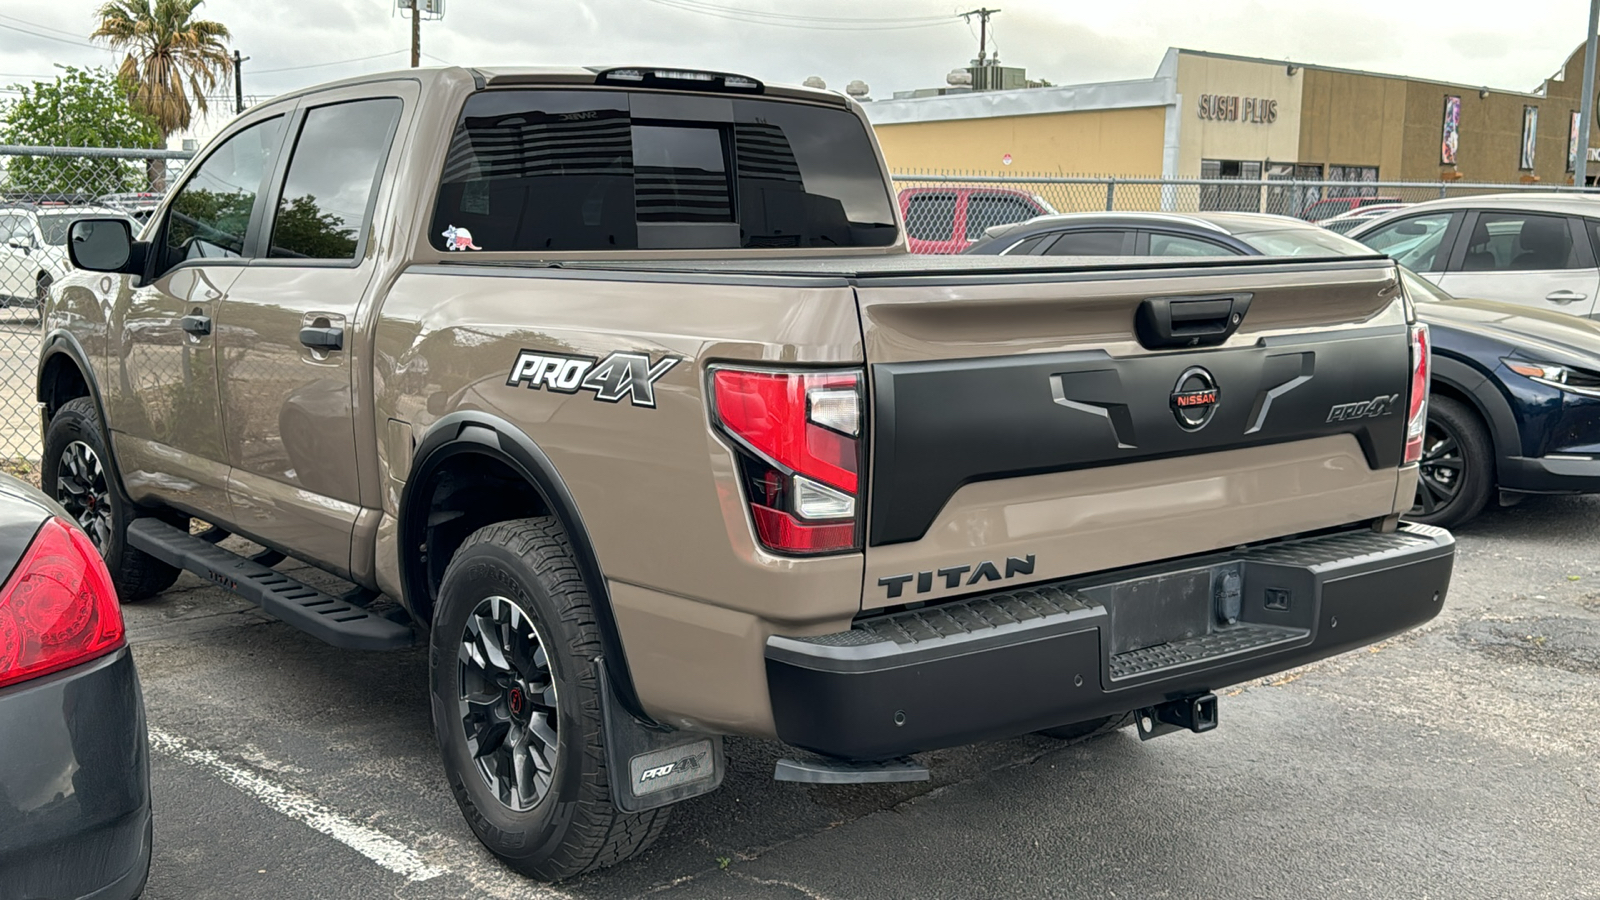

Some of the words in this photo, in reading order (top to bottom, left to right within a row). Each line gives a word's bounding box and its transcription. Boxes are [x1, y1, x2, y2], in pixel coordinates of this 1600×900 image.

[1198, 94, 1239, 121] SUSHI
[1242, 97, 1278, 123] PLUS
[507, 349, 683, 409] PRO4X
[1177, 393, 1216, 407] NISSAN
[1325, 394, 1399, 423] PRO4X
[877, 553, 1036, 599] TITAN
[638, 751, 707, 783] PRO4X
